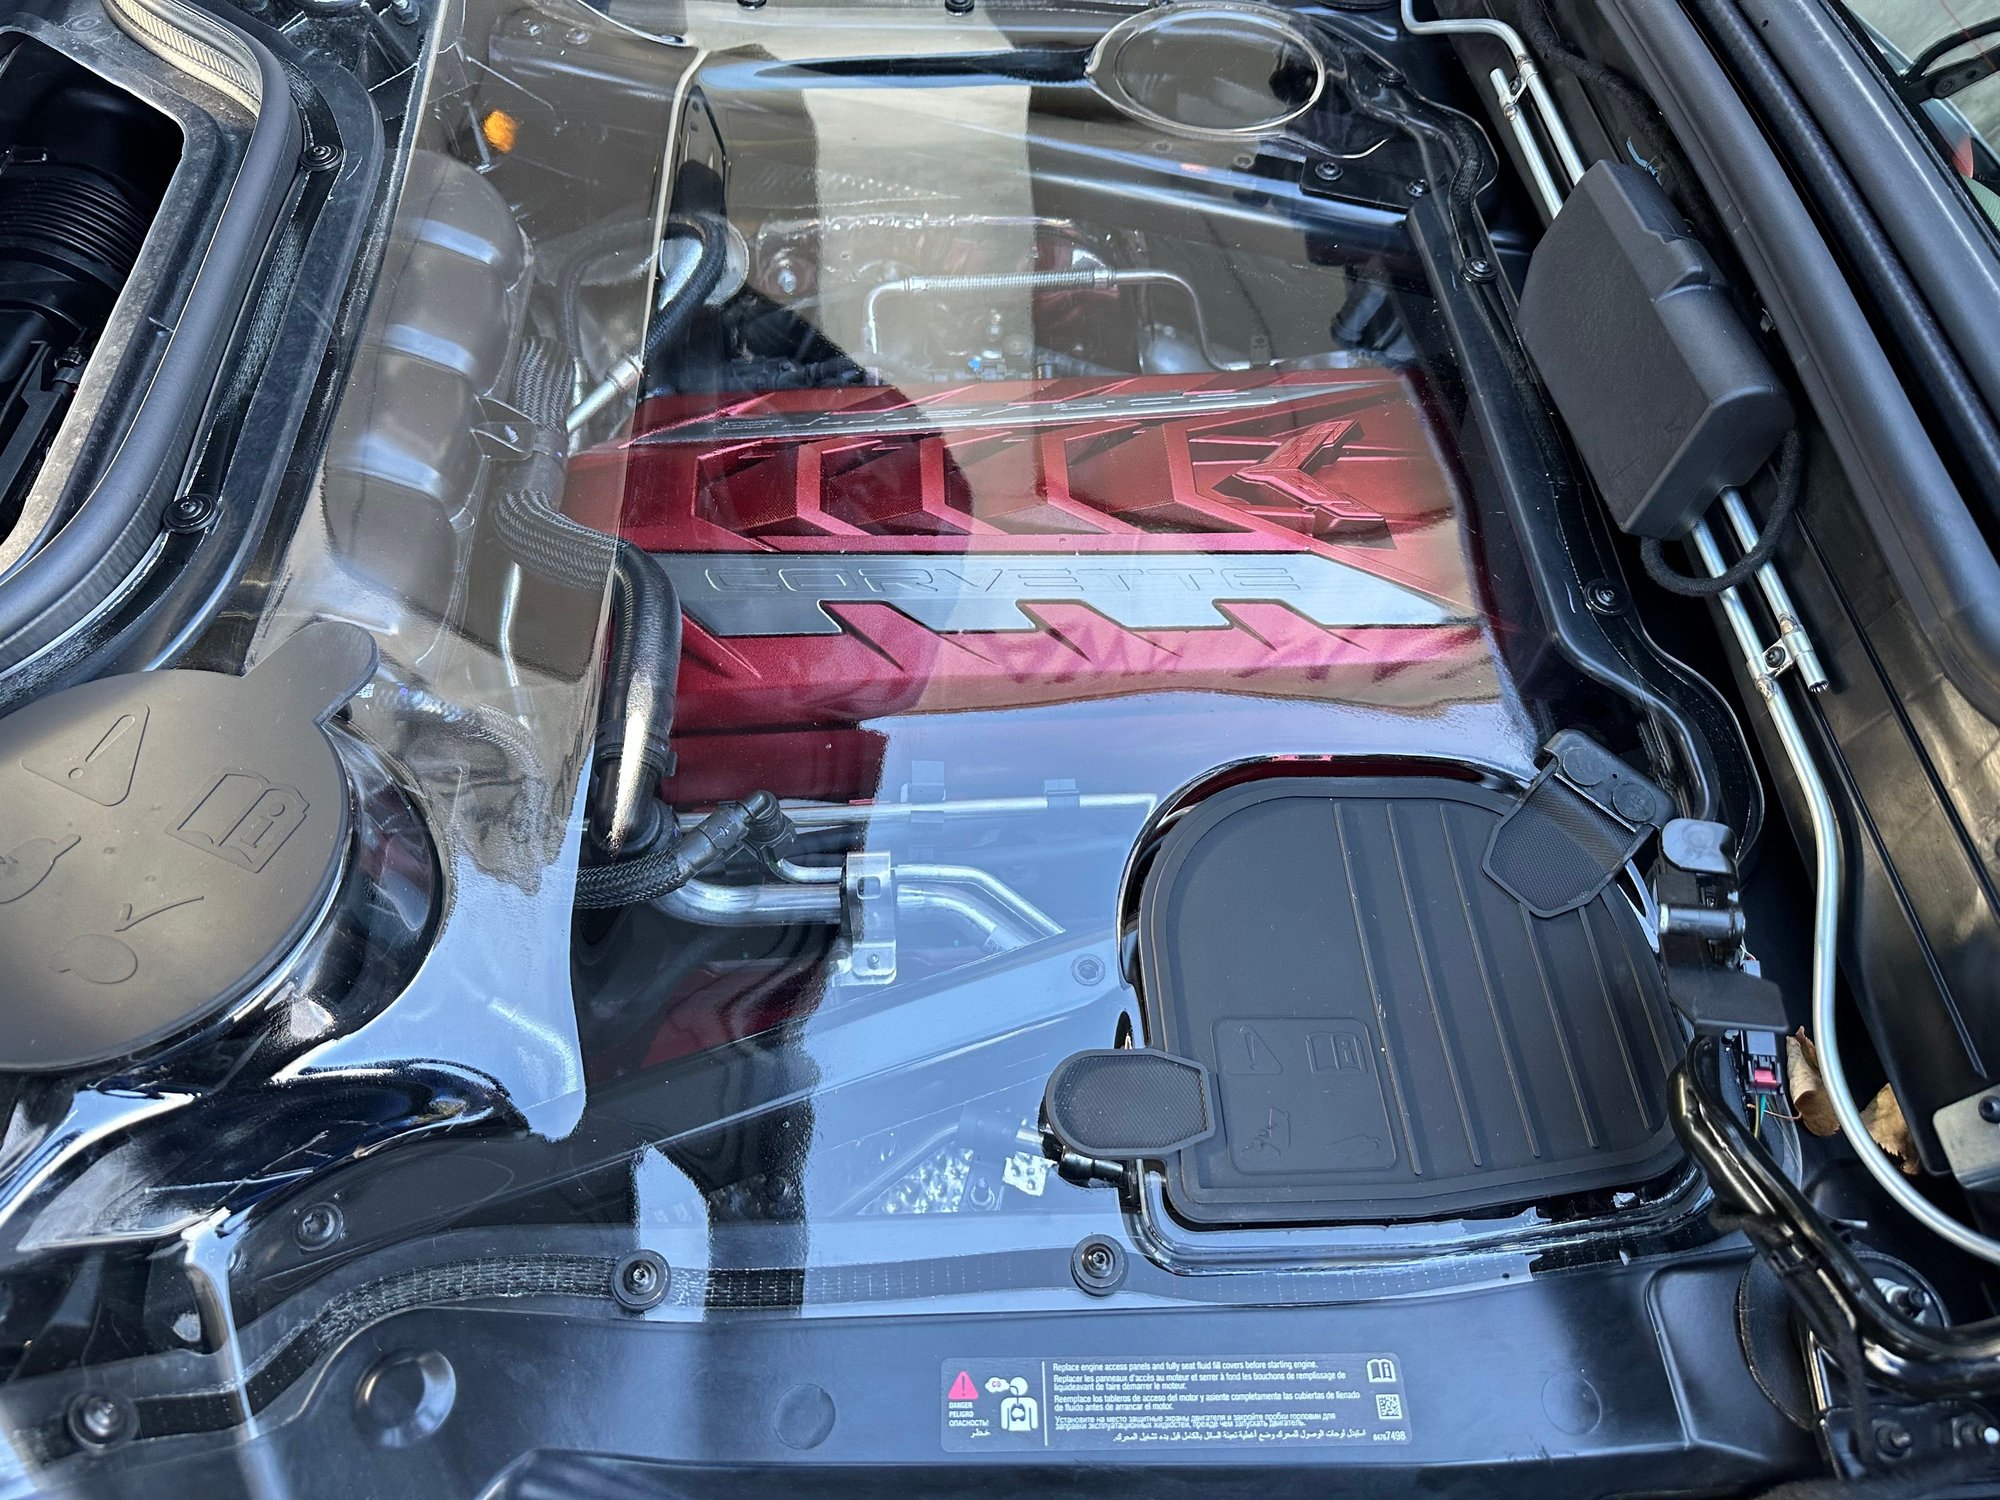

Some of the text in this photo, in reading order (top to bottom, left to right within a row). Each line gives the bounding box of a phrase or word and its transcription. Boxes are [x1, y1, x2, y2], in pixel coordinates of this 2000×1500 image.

[705, 567, 1300, 593] CORVETTE
[1053, 1363, 1080, 1373] Replace
[1081, 1362, 1103, 1372] engine
[1129, 1362, 1151, 1372] panels
[1152, 1362, 1164, 1370] and
[1166, 1362, 1180, 1372] fully
[1181, 1362, 1196, 1370] seat
[1267, 1361, 1292, 1370] starting
[1294, 1361, 1318, 1370] engine.
[1054, 1374, 1083, 1384] Replacer
[1095, 1375, 1128, 1383] panneaux
[1166, 1373, 1190, 1381] moteur
[1191, 1373, 1198, 1381] et
[1220, 1372, 1225, 1380] à
[1226, 1372, 1241, 1380] fond
[1242, 1372, 1252, 1380] les
[1253, 1372, 1285, 1380] bouchons
[1286, 1372, 1295, 1380] de
[1296, 1371, 1336, 1381] remplissage
[1337, 1371, 1346, 1379] de
[1054, 1394, 1091, 1404] Reemplace
[1092, 1394, 1103, 1402] los
[1104, 1394, 1131, 1402] tableros
[1132, 1394, 1141, 1402] de
[1167, 1393, 1178, 1401] del
[1179, 1393, 1198, 1401] motor
[1200, 1394, 1204, 1403] y
[1205, 1392, 1230, 1401] asiente
[1231, 1392, 1282, 1402] completamente
[1282, 1392, 1294, 1400] las
[1294, 1391, 1325, 1399] cubiertas
[1326, 1391, 1335, 1399] de
[1336, 1391, 1361, 1399] llenado
[1054, 1403, 1064, 1412] de
[1065, 1403, 1084, 1411] fluido
[1085, 1403, 1104, 1411] antes
[970, 1428, 990, 1438] خطر
